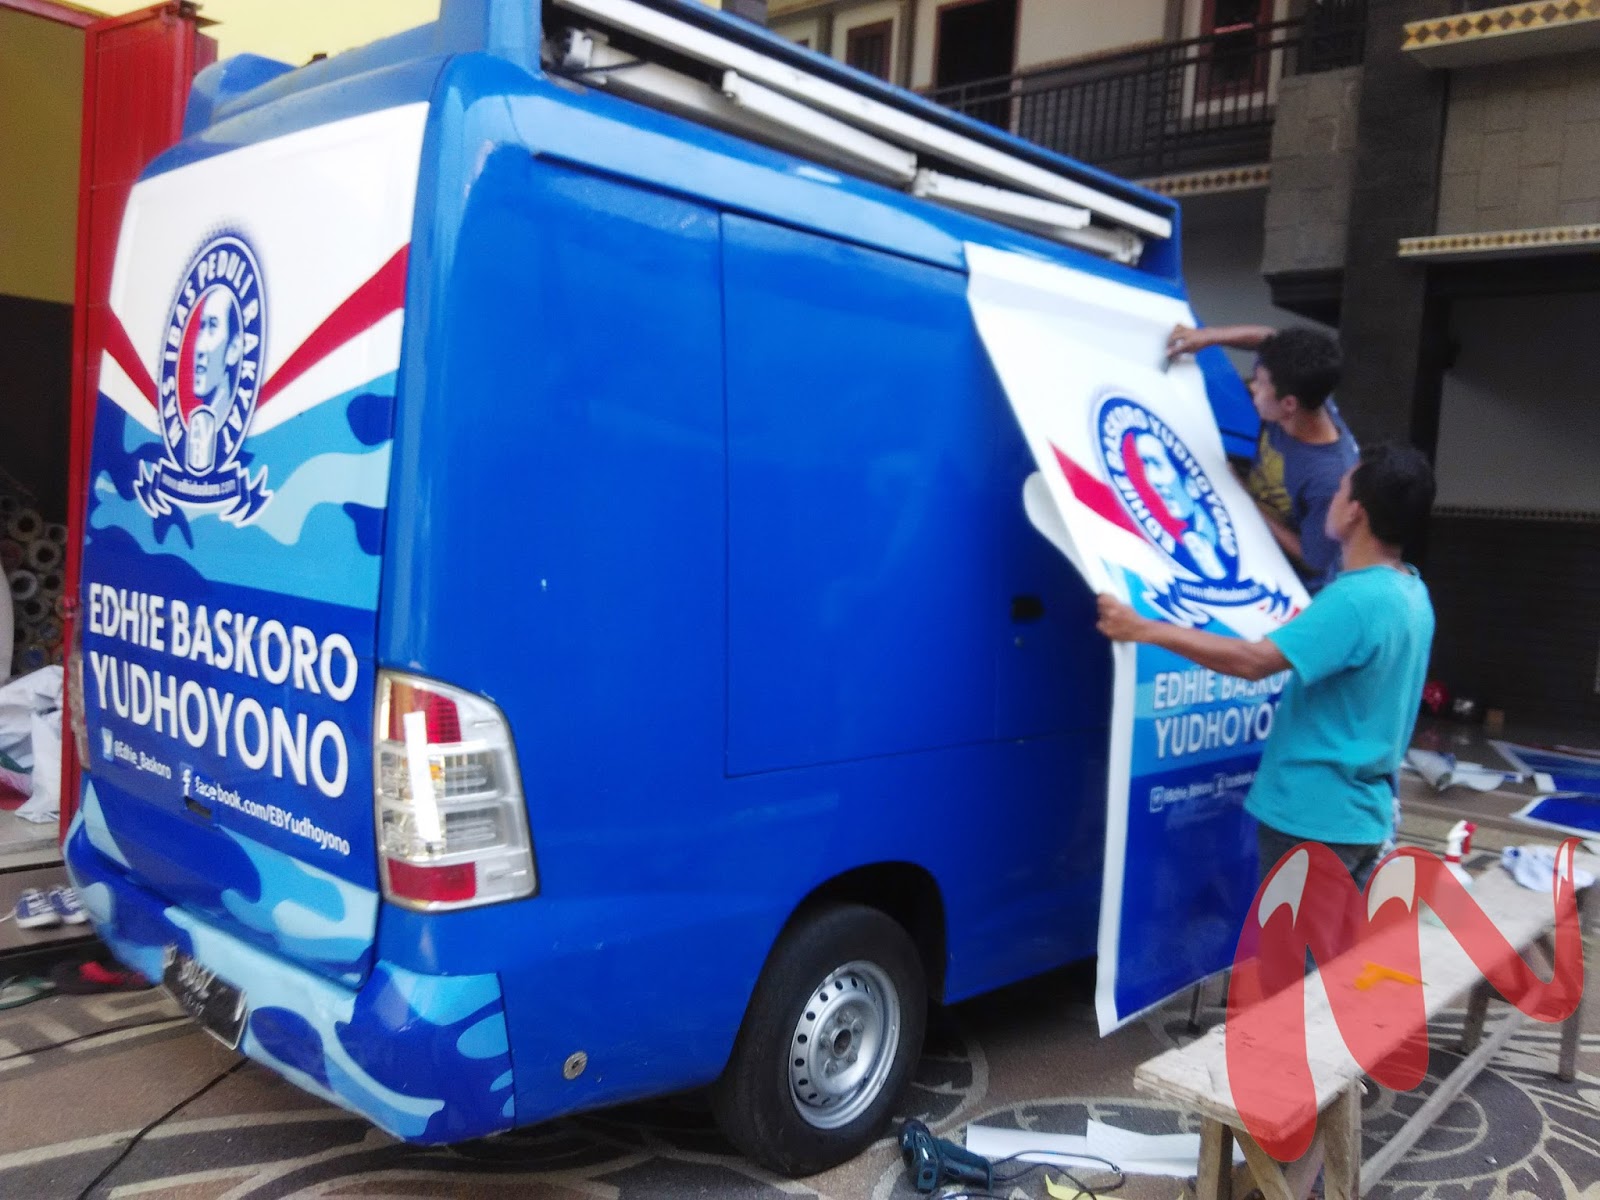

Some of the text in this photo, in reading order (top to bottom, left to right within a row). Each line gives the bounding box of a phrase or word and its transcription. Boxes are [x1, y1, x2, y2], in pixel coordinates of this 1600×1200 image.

[197, 250, 254, 297] PEDULI
[222, 299, 260, 455] RAKYAT
[89, 582, 358, 702] EDHIE BASKORO
[90, 650, 349, 798] YUDHOYONO
[1154, 669, 1215, 709] EDHIE
[1155, 702, 1280, 758] YUDHOYO
